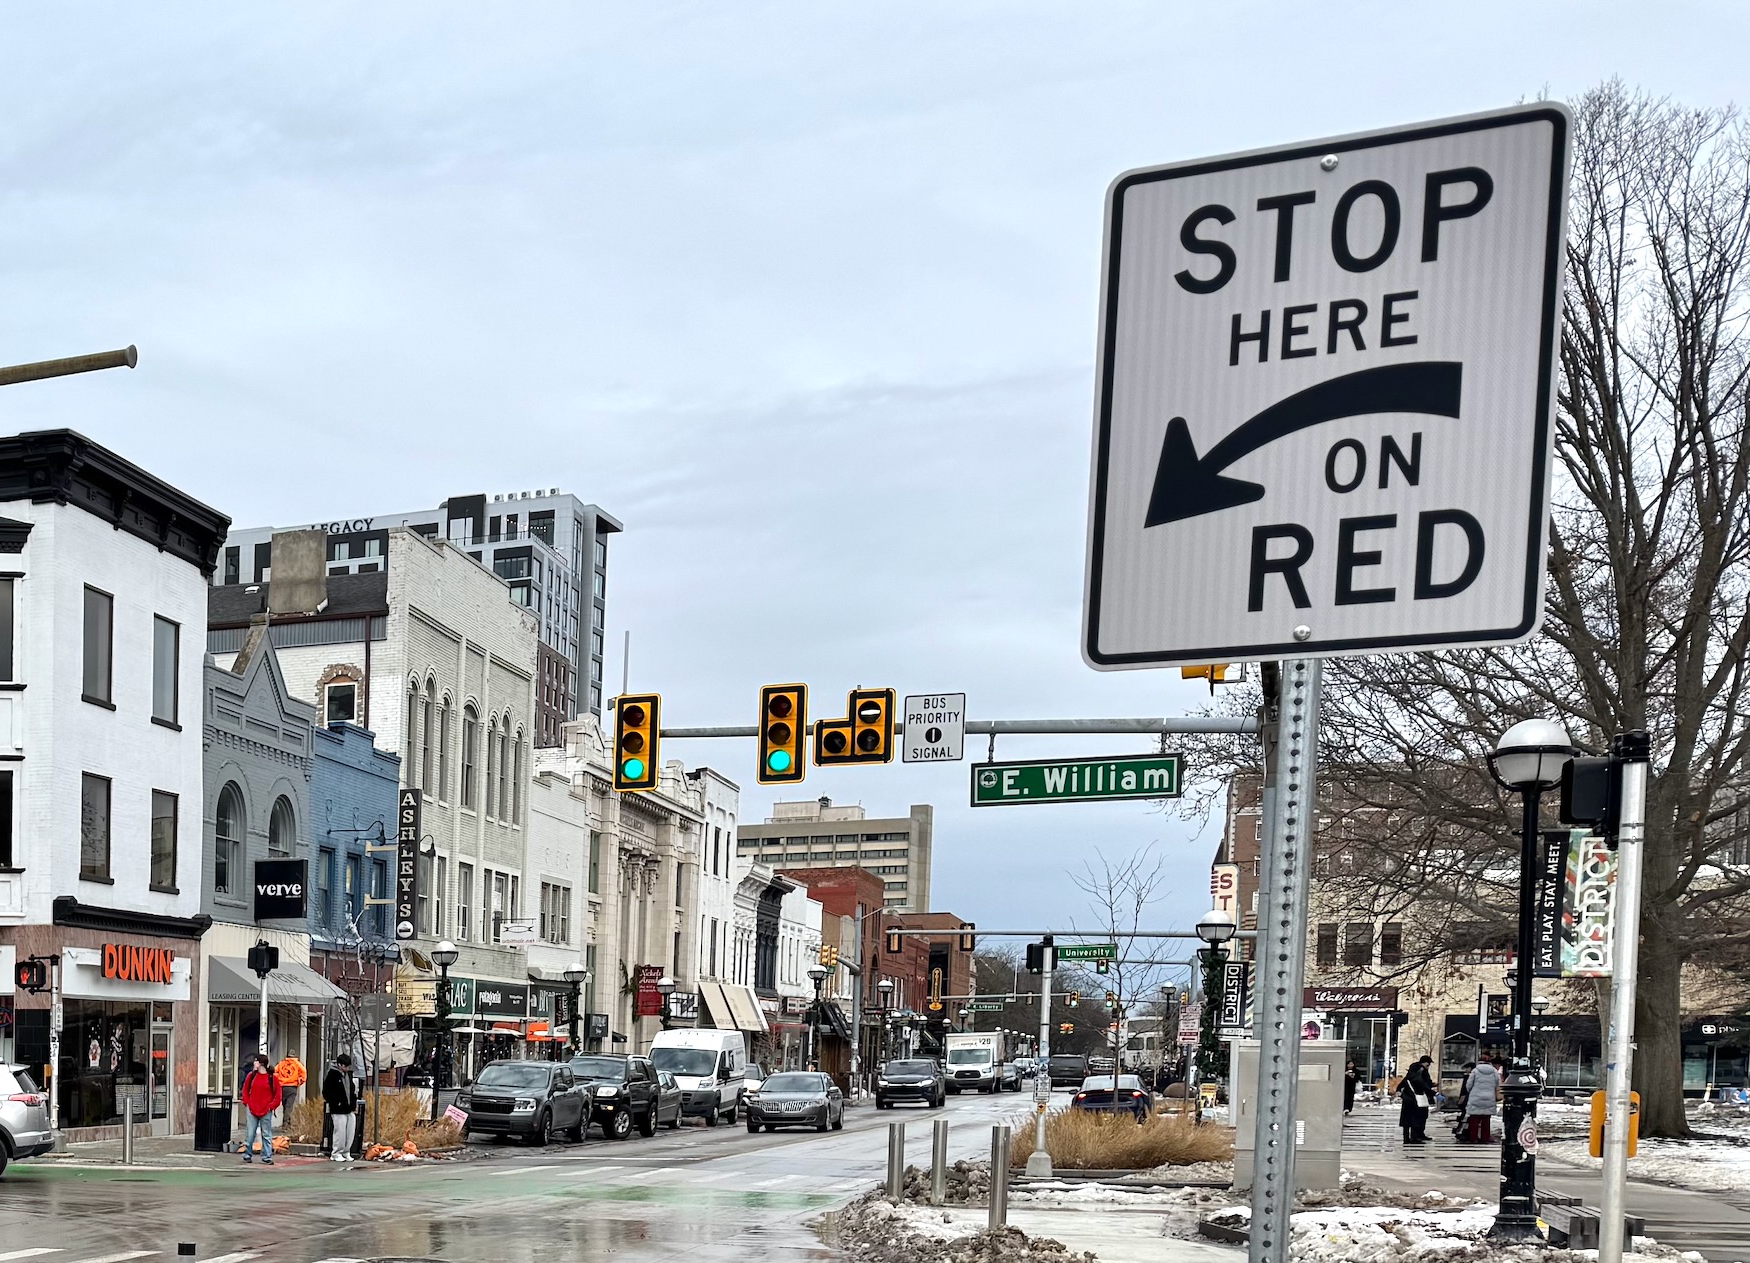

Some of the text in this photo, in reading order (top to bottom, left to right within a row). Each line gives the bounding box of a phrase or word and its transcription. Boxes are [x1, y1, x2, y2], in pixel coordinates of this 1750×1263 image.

[1172, 166, 1495, 295] STOP
[1228, 289, 1420, 367] HERE
[1324, 431, 1423, 494] ON
[1247, 507, 1487, 613] RED
[908, 711, 960, 725] PRIORITY
[923, 697, 946, 710] BUS
[912, 746, 953, 759] SIGNAL
[1002, 764, 1169, 796] E. William
[256, 883, 302, 896] verve
[1541, 841, 1561, 968] EAT. PLAY. STAY. MEET.
[1580, 842, 1611, 968] DISTRICT
[103, 943, 175, 984] DUNKIN'
[1065, 947, 1110, 957] University
[1224, 965, 1239, 1024] DISTRICT
